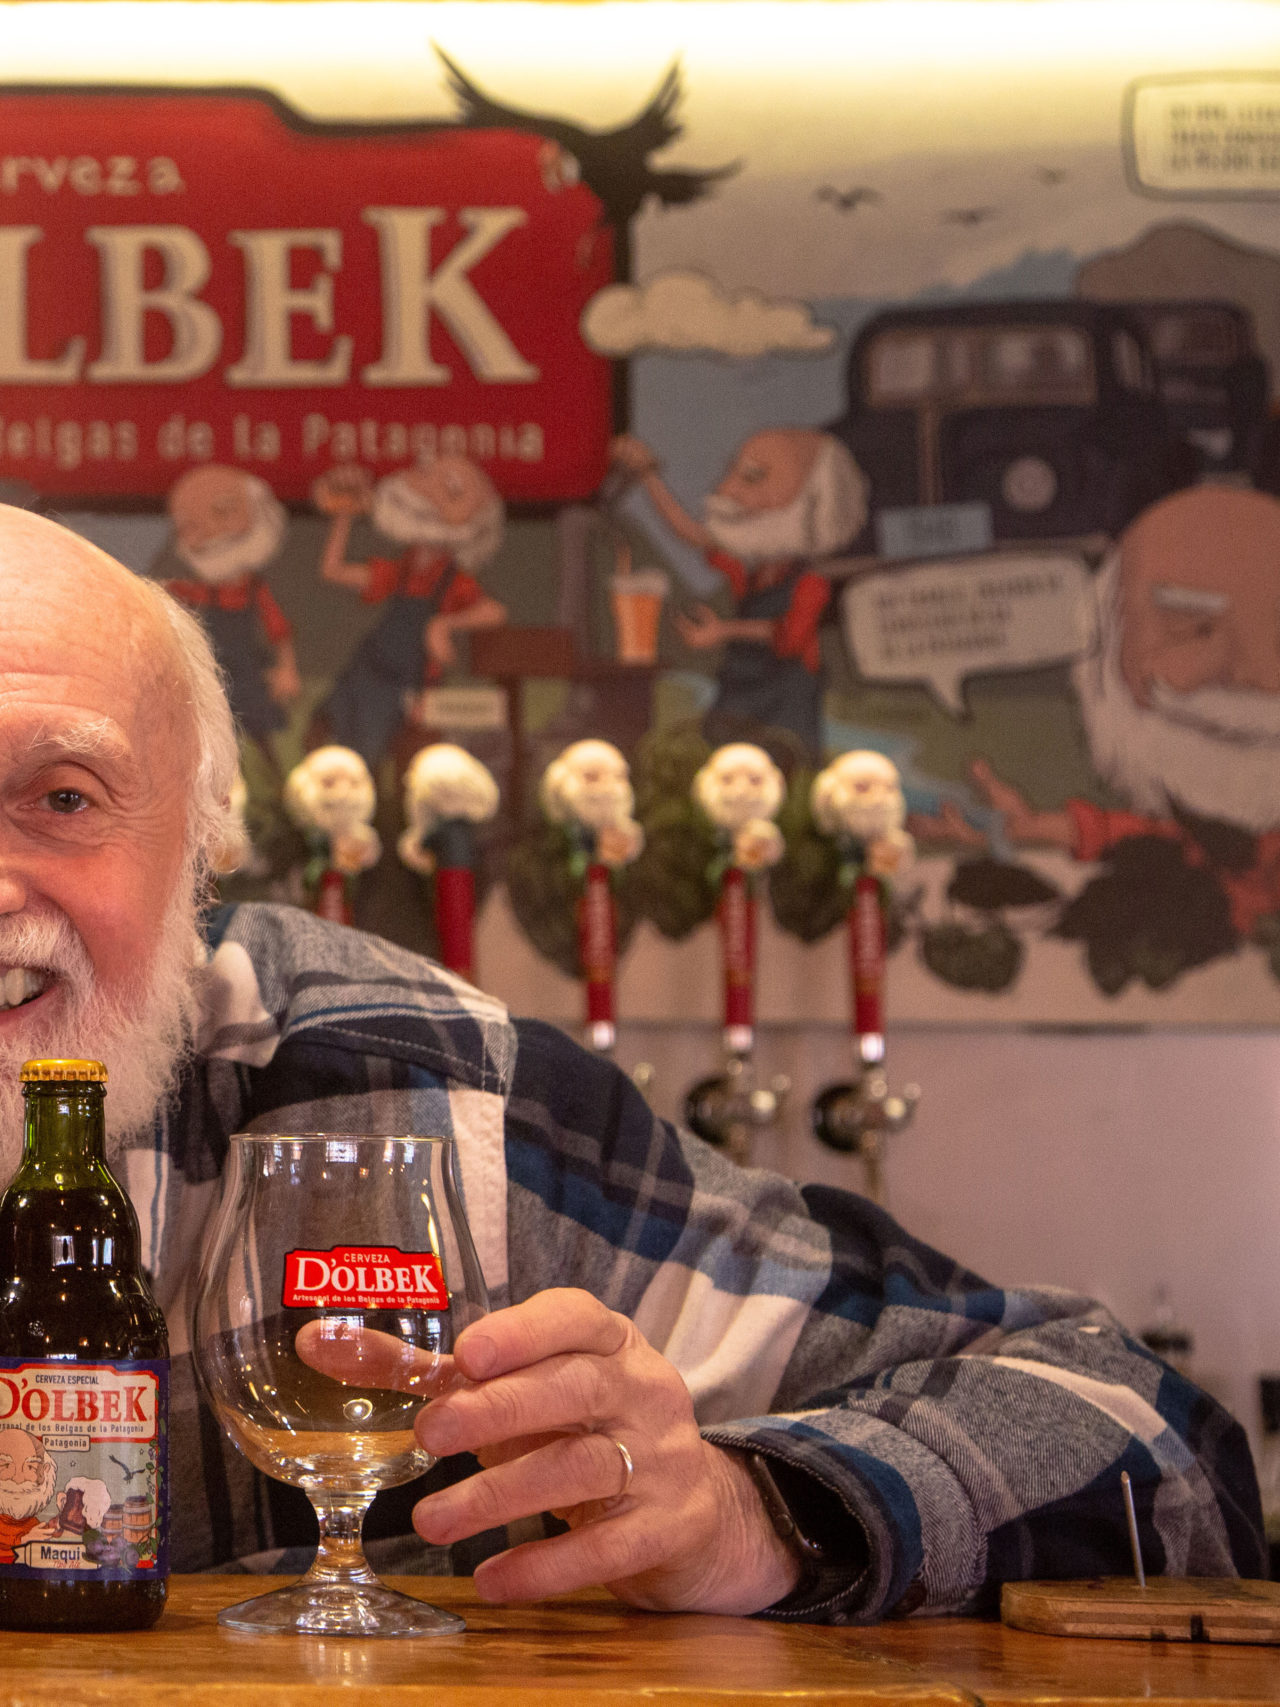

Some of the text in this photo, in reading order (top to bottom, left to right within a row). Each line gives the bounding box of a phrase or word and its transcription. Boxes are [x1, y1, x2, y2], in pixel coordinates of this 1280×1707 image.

[157, 412, 215, 462] de
[233, 412, 282, 462] la
[302, 412, 545, 467] Patagonia
[343, 1253, 390, 1264] CERVEZA
[294, 1257, 438, 1293] D'OLBEK
[332, 1294, 341, 1302] de
[343, 1294, 356, 1303] los
[386, 1295, 396, 1303] de
[35, 1374, 99, 1385] CERVEZA ESPECIAL
[25, 1422, 35, 1431] de
[38, 1422, 51, 1431] los
[55, 1423, 83, 1435] Belgas
[87, 1424, 97, 1433] de
[99, 1424, 108, 1433] la
[110, 1424, 144, 1436] Patagonia
[44, 1437, 87, 1449] Patagonia
[40, 1546, 80, 1564] Maqui
